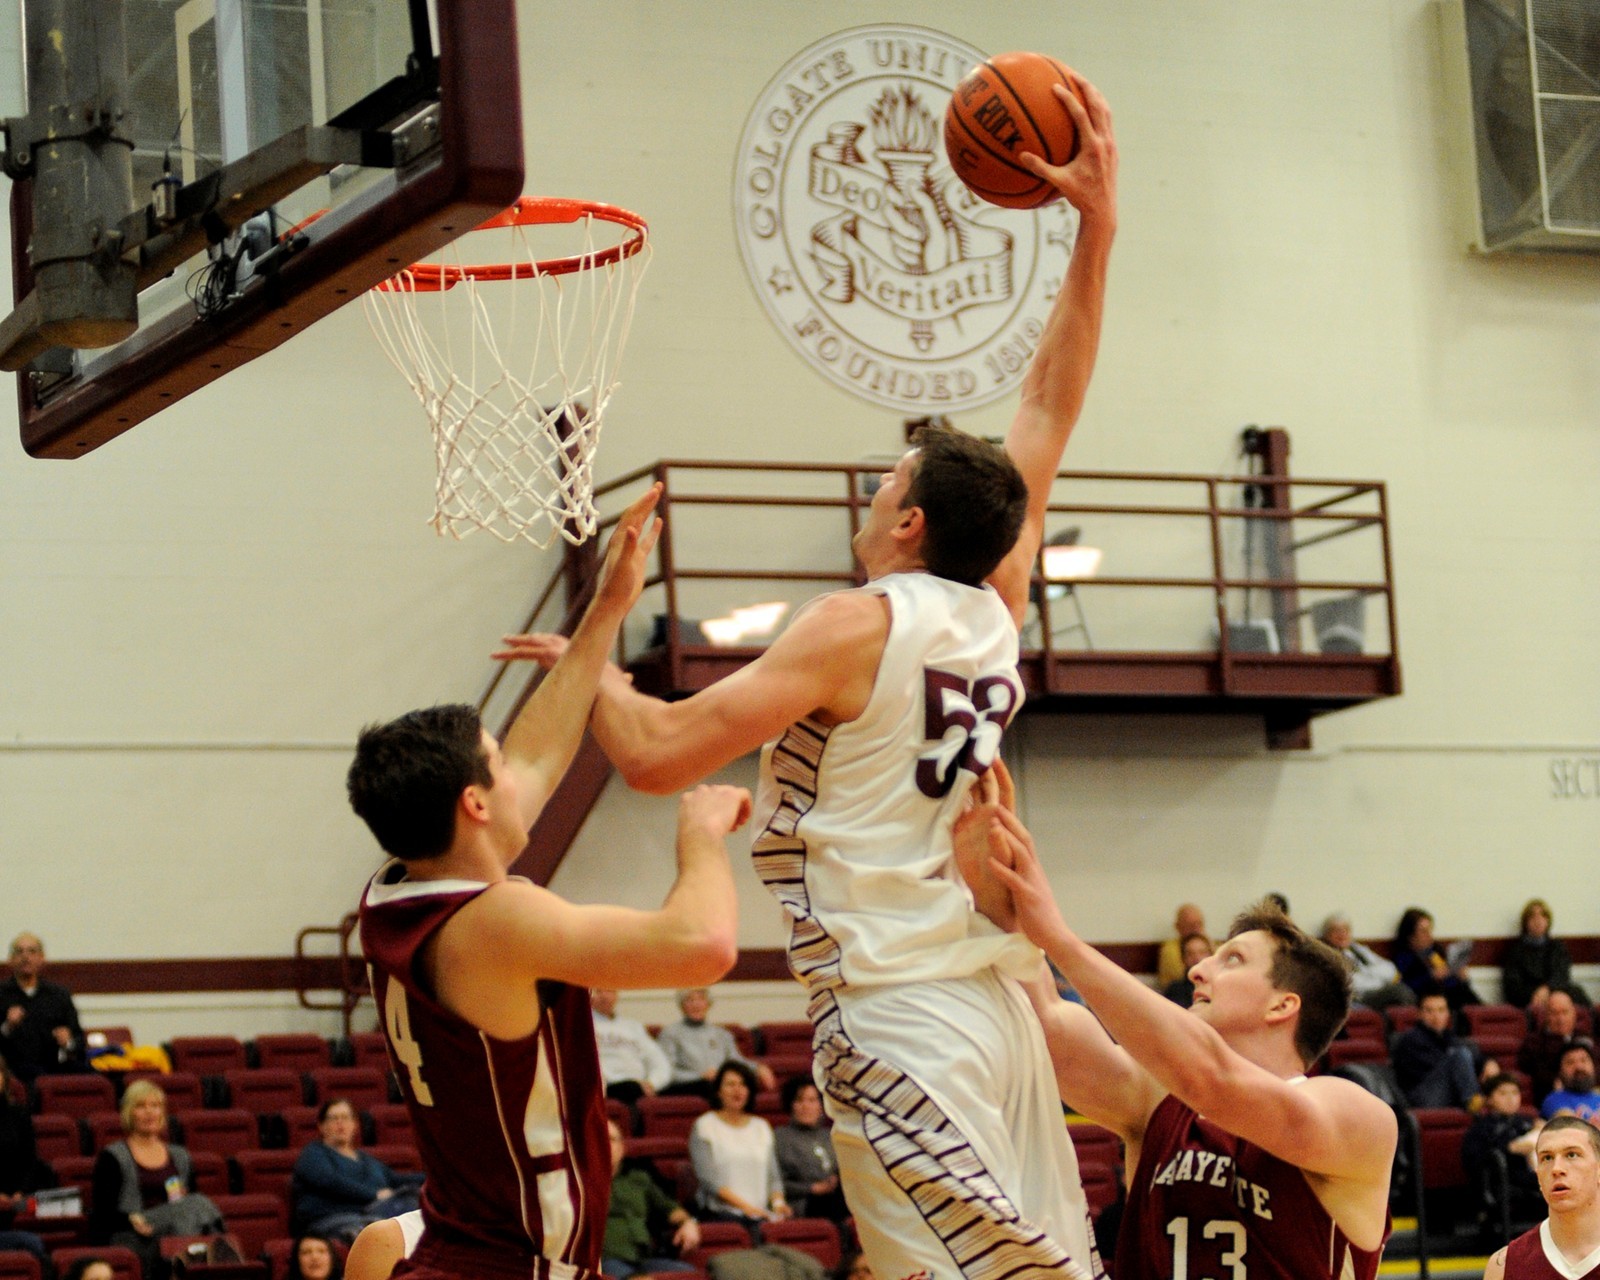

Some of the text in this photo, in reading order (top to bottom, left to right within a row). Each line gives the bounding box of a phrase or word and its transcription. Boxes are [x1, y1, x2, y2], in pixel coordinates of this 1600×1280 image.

[748, 50, 855, 240] COLGATE
[973, 93, 1025, 152] ROCK
[818, 166, 883, 212] Deo
[858, 256, 994, 312] Veritati
[794, 308, 1044, 401] FOUNDED 1819
[380, 972, 434, 1107] 4
[1166, 1216, 1248, 1280] 13
